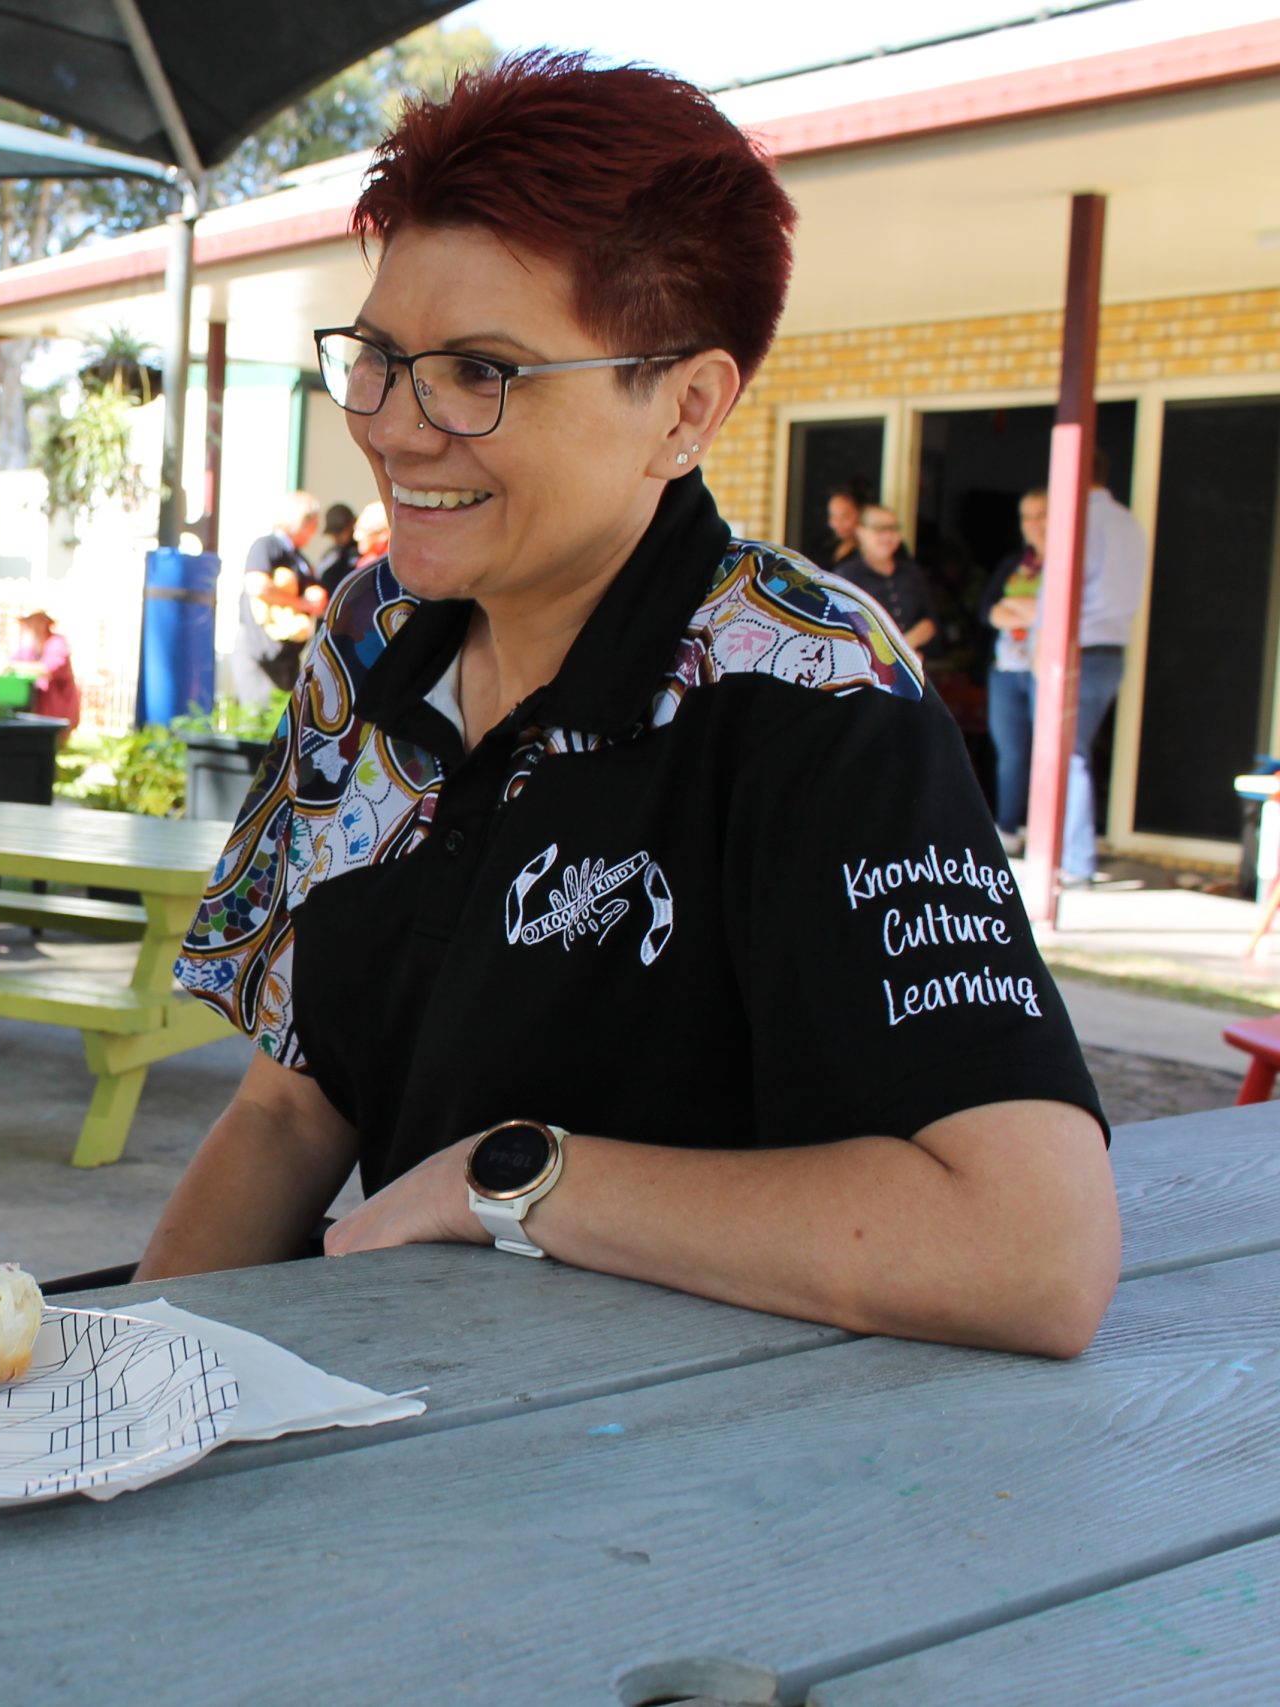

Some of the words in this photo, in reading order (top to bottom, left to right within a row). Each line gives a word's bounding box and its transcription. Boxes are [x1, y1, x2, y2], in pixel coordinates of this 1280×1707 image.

[594, 861, 636, 894] KINDY
[842, 844, 1014, 910] Knowledge
[883, 903, 1011, 956] Culture
[883, 966, 1043, 1026] Learning
